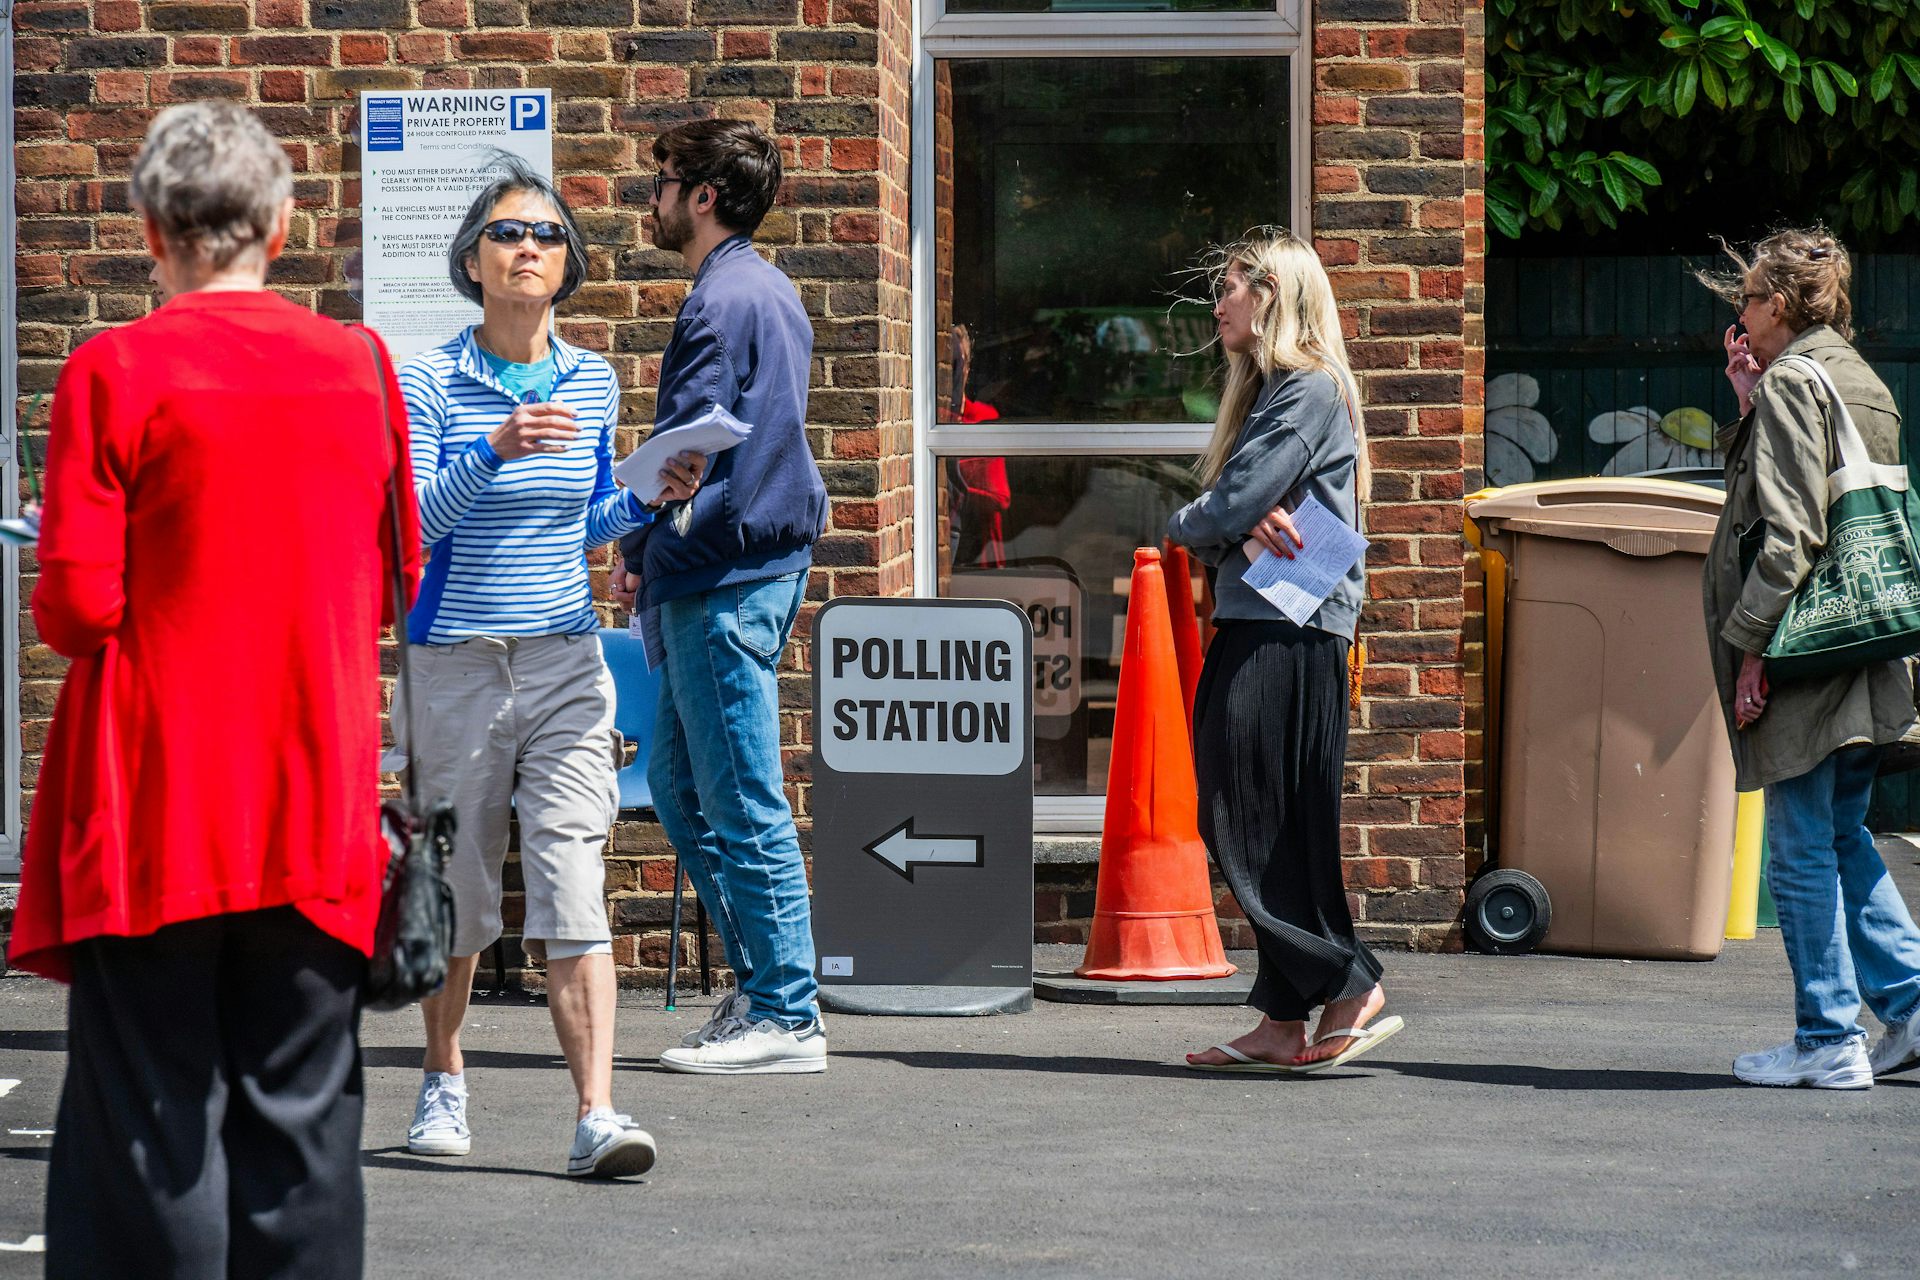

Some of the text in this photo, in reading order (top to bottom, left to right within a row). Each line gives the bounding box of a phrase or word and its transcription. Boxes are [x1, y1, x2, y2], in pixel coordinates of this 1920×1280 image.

[407, 95, 506, 112] WARNING
[515, 97, 541, 129] P
[407, 117, 506, 128] PRIVATE PROPERTY
[457, 142, 494, 150] Conditions
[1838, 528, 1874, 543] BOOKS
[832, 637, 1012, 682] POLLING
[832, 698, 1011, 743] STATION
